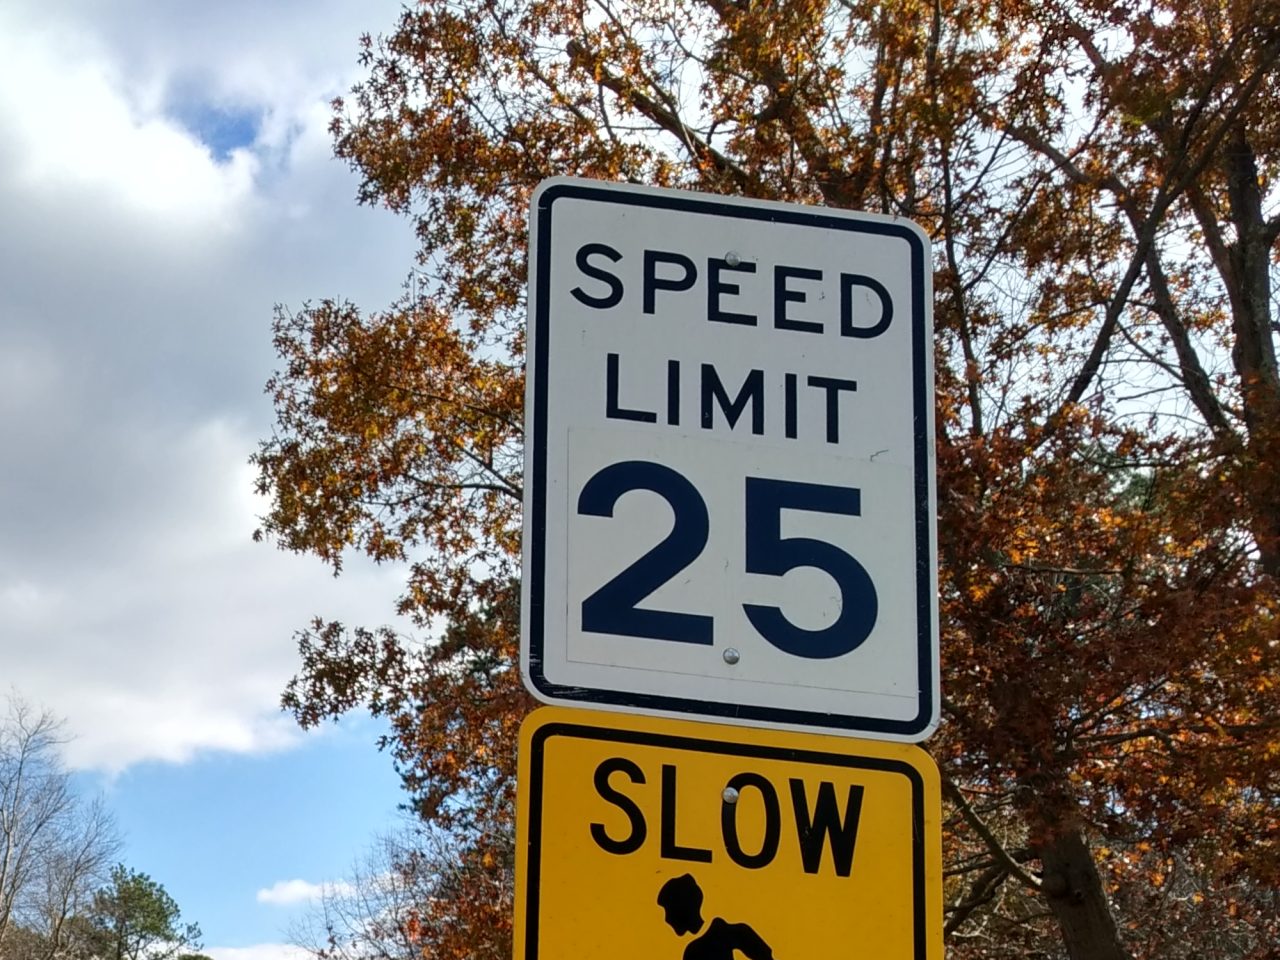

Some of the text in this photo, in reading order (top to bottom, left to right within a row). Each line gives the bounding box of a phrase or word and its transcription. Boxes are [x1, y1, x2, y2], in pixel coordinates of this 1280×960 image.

[570, 243, 893, 339] SPEED
[606, 353, 857, 444] LIMIT
[577, 460, 878, 659] 25
[590, 757, 864, 877] SLOW
